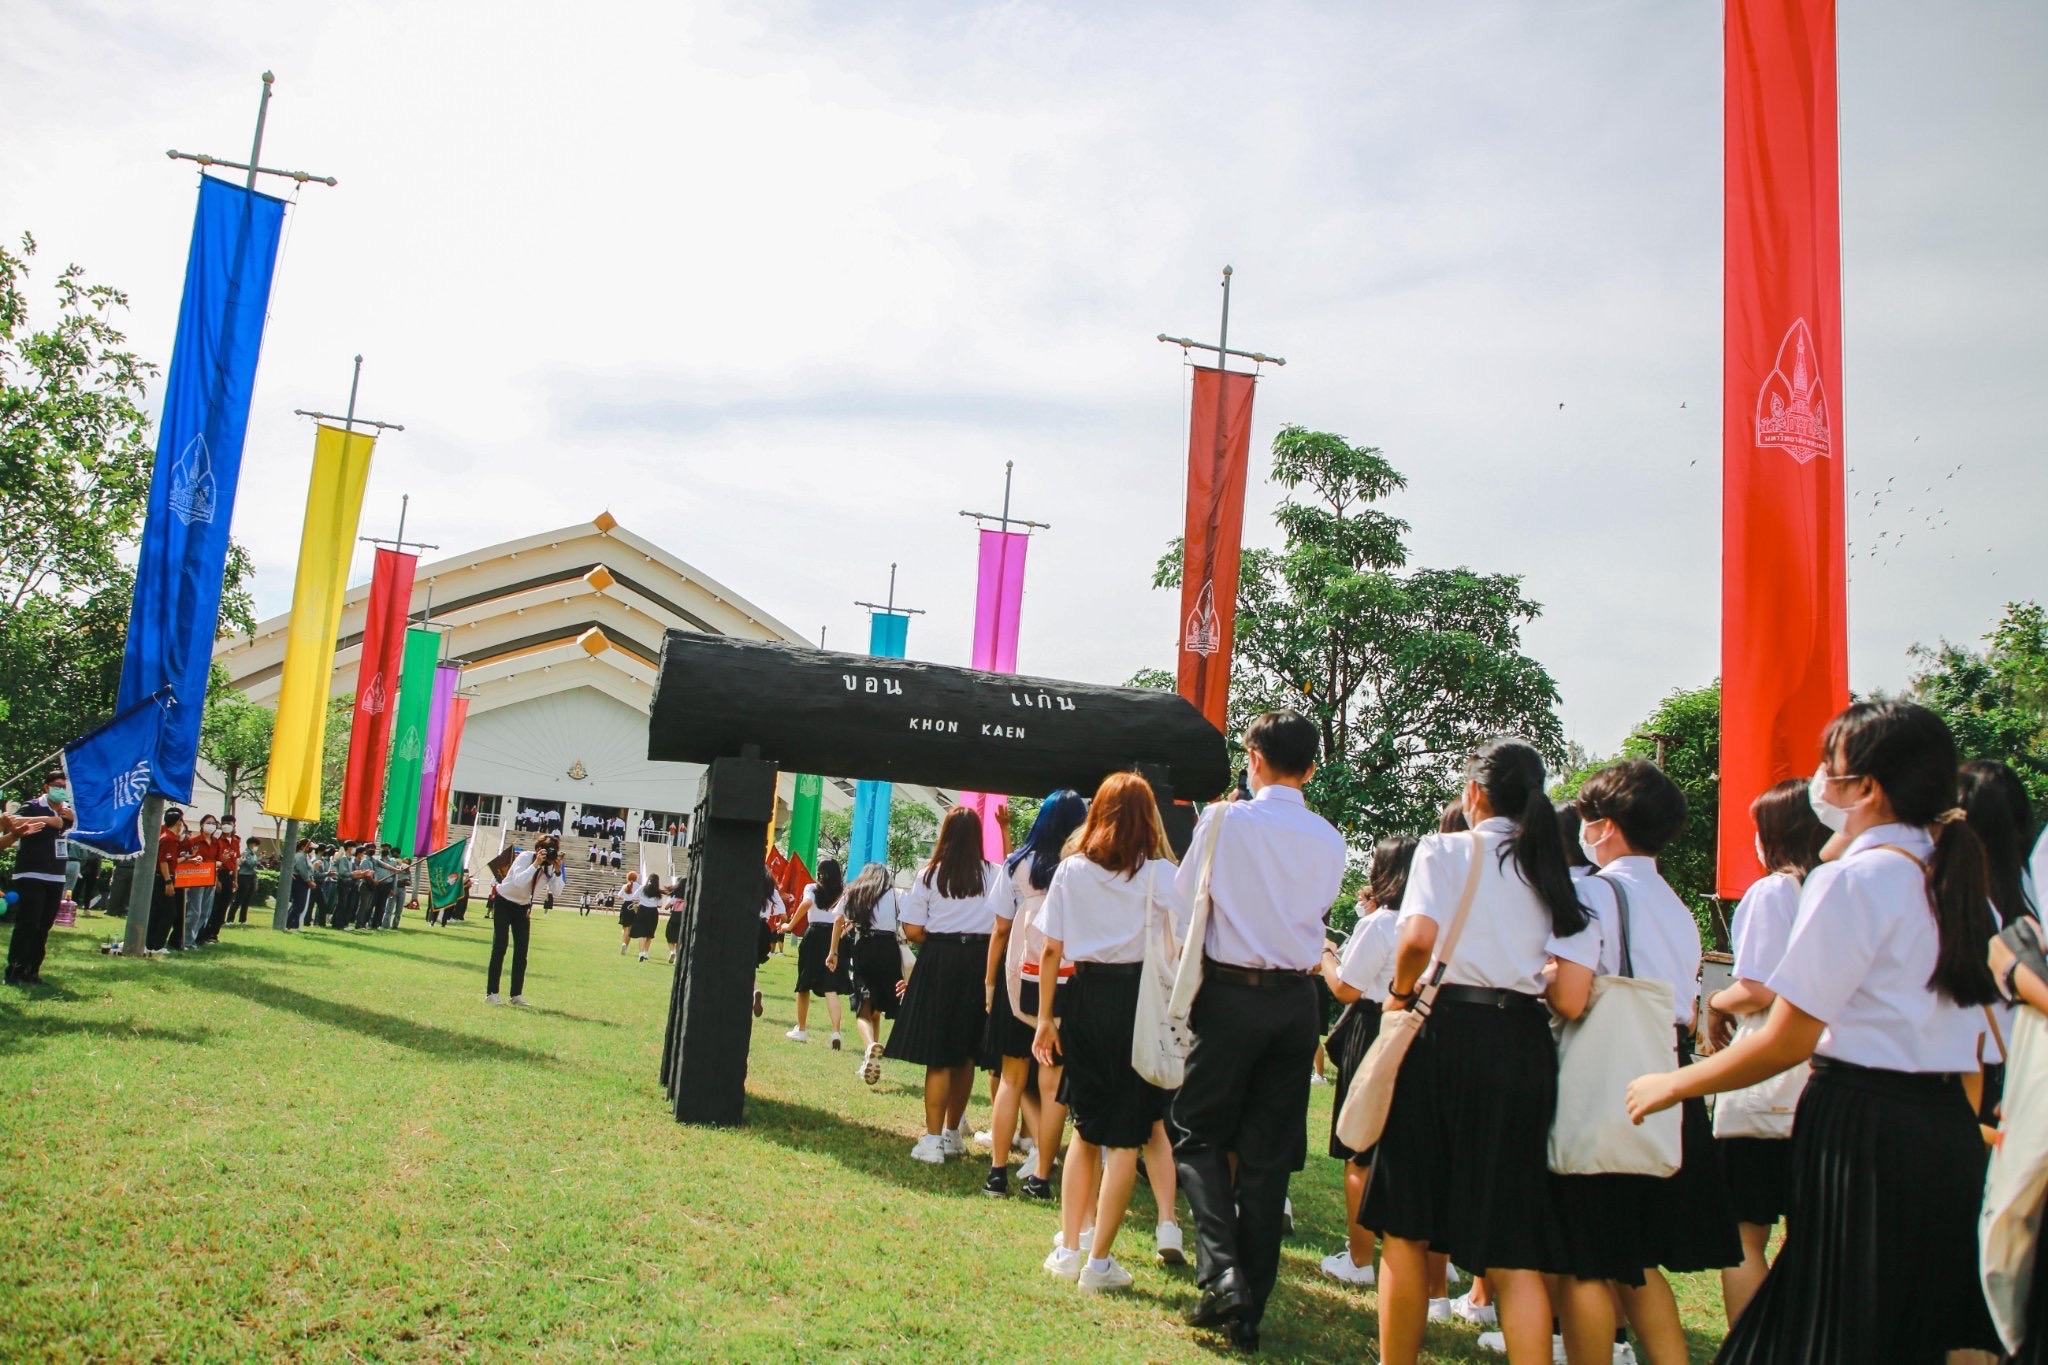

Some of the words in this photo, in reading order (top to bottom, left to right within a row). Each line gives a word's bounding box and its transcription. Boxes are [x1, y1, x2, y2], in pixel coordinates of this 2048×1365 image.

[842, 674, 903, 695] ขอน
[1011, 689, 1076, 711] แก่น
[909, 718, 959, 733] KHON
[981, 724, 1026, 739] KAEN
